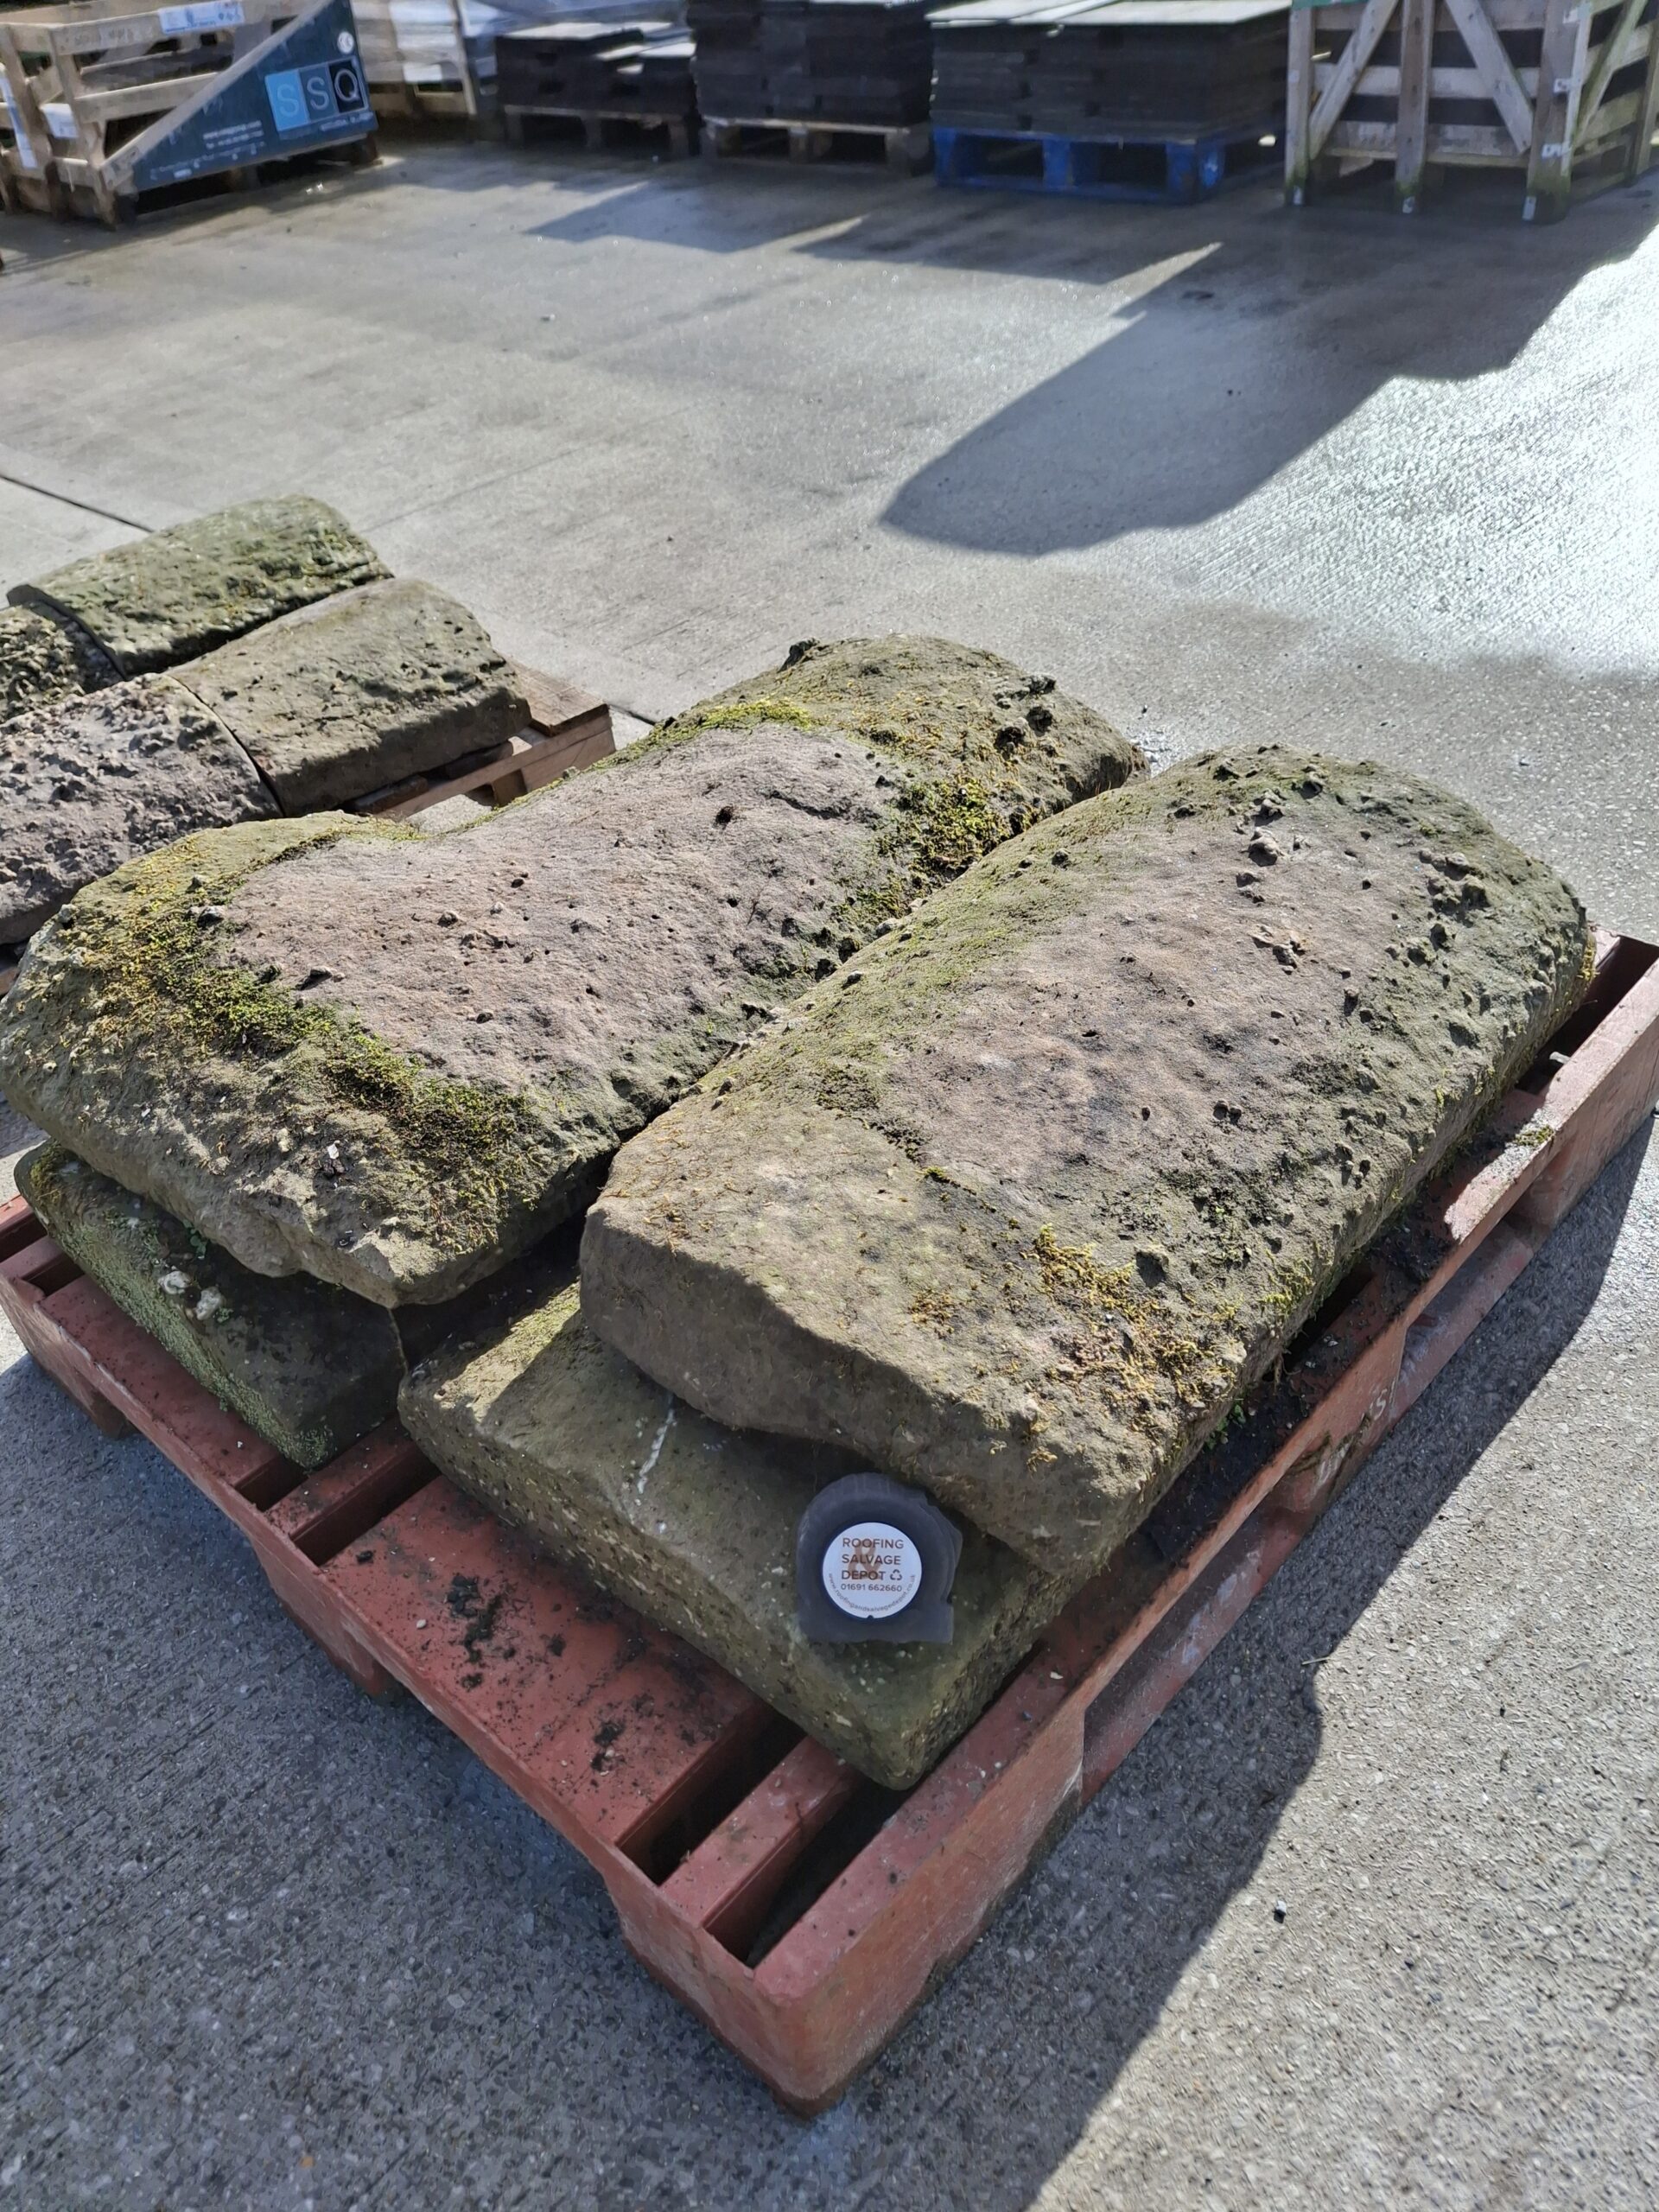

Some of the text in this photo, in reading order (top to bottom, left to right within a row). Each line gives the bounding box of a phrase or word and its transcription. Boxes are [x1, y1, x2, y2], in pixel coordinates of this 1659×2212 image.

[276, 68, 361, 117] SSQ
[842, 1538, 904, 1549] ROOFING
[842, 1554, 901, 1565] SALVAGE
[842, 1570, 886, 1580] DEPOT
[868, 1584, 902, 1592] 662660
